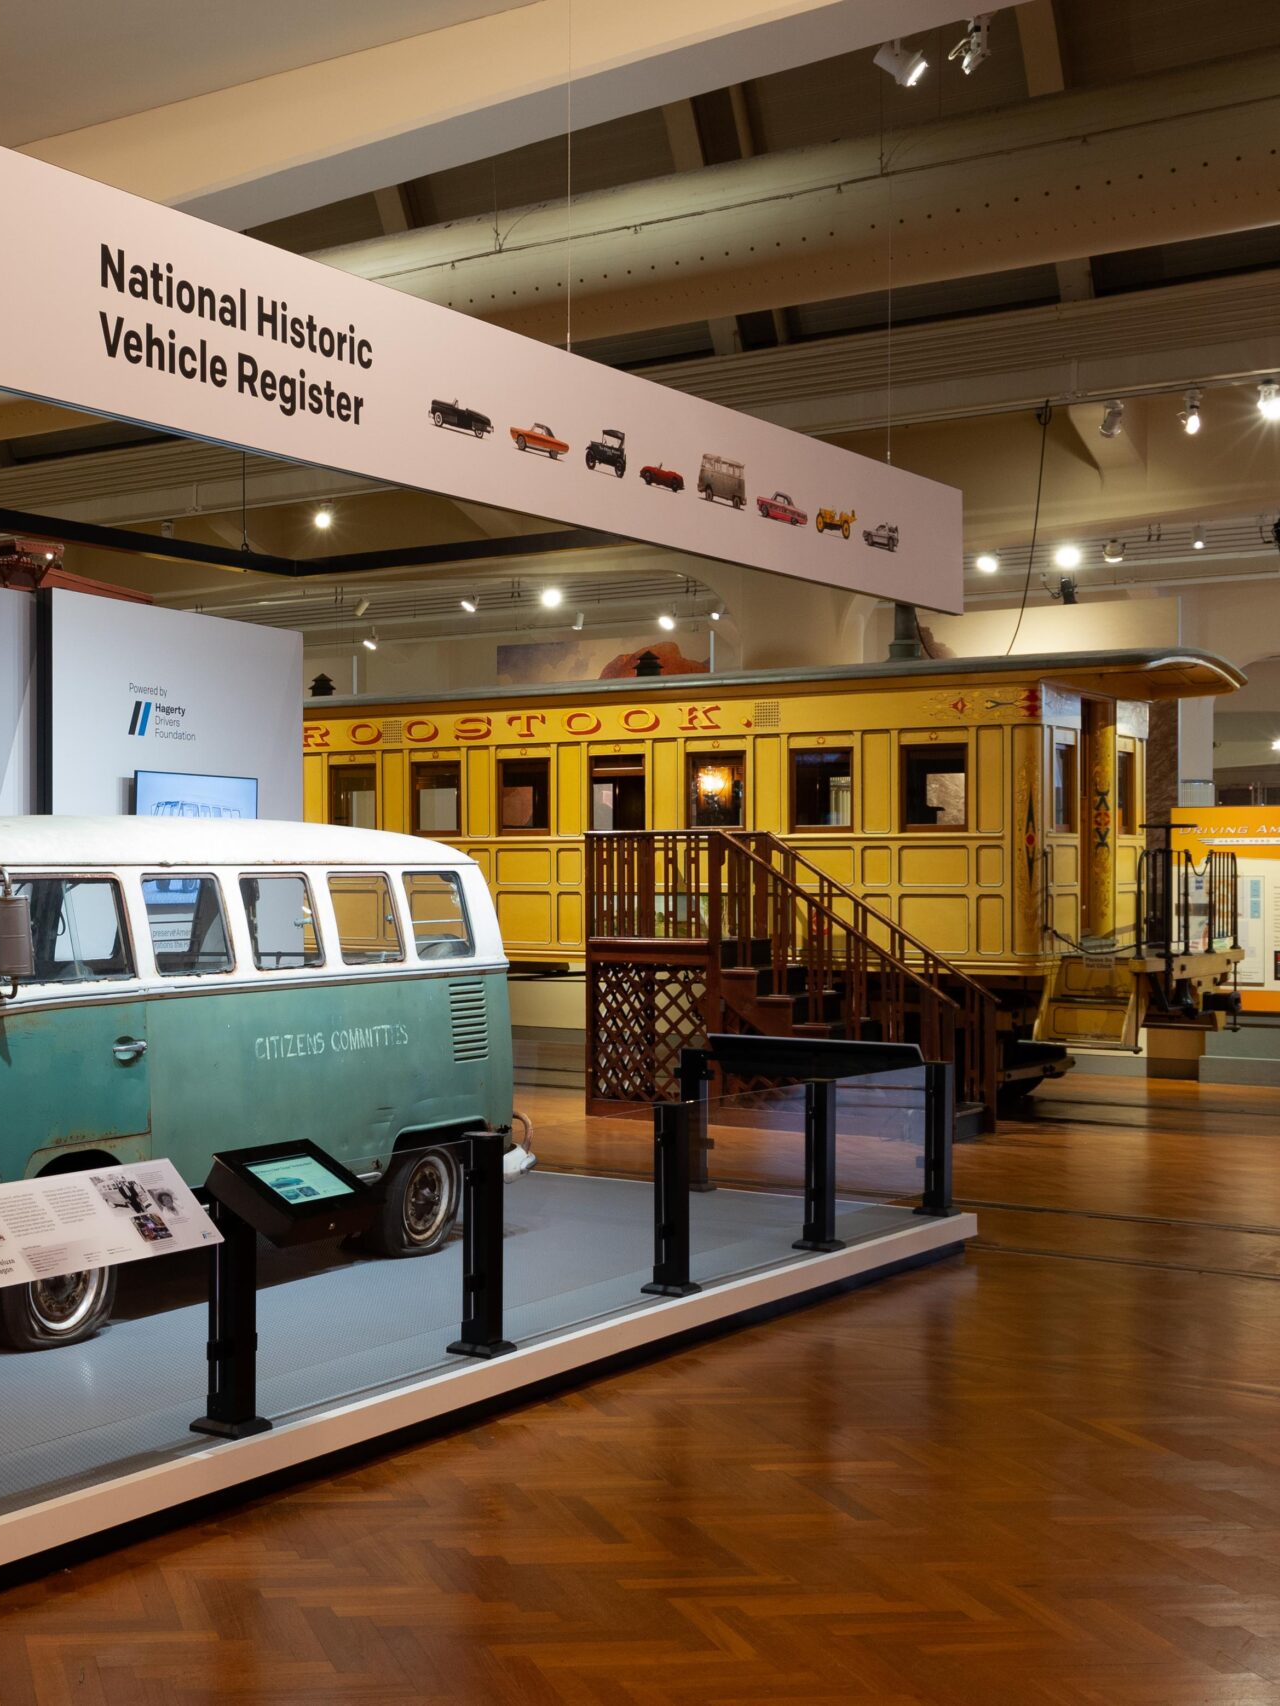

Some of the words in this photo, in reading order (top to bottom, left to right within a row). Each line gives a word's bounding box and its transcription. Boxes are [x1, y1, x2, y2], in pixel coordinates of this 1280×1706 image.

[100, 242, 246, 331] National
[257, 295, 373, 369] Historic
[99, 310, 228, 388] Vehicle
[237, 351, 364, 425] Register
[129, 682, 159, 696] Powered
[159, 685, 168, 698] by
[155, 702, 186, 717] Hagerty
[154, 715, 181, 728] Drivers
[154, 727, 196, 742] Foundation
[254, 1032, 325, 1060] CITIZENS
